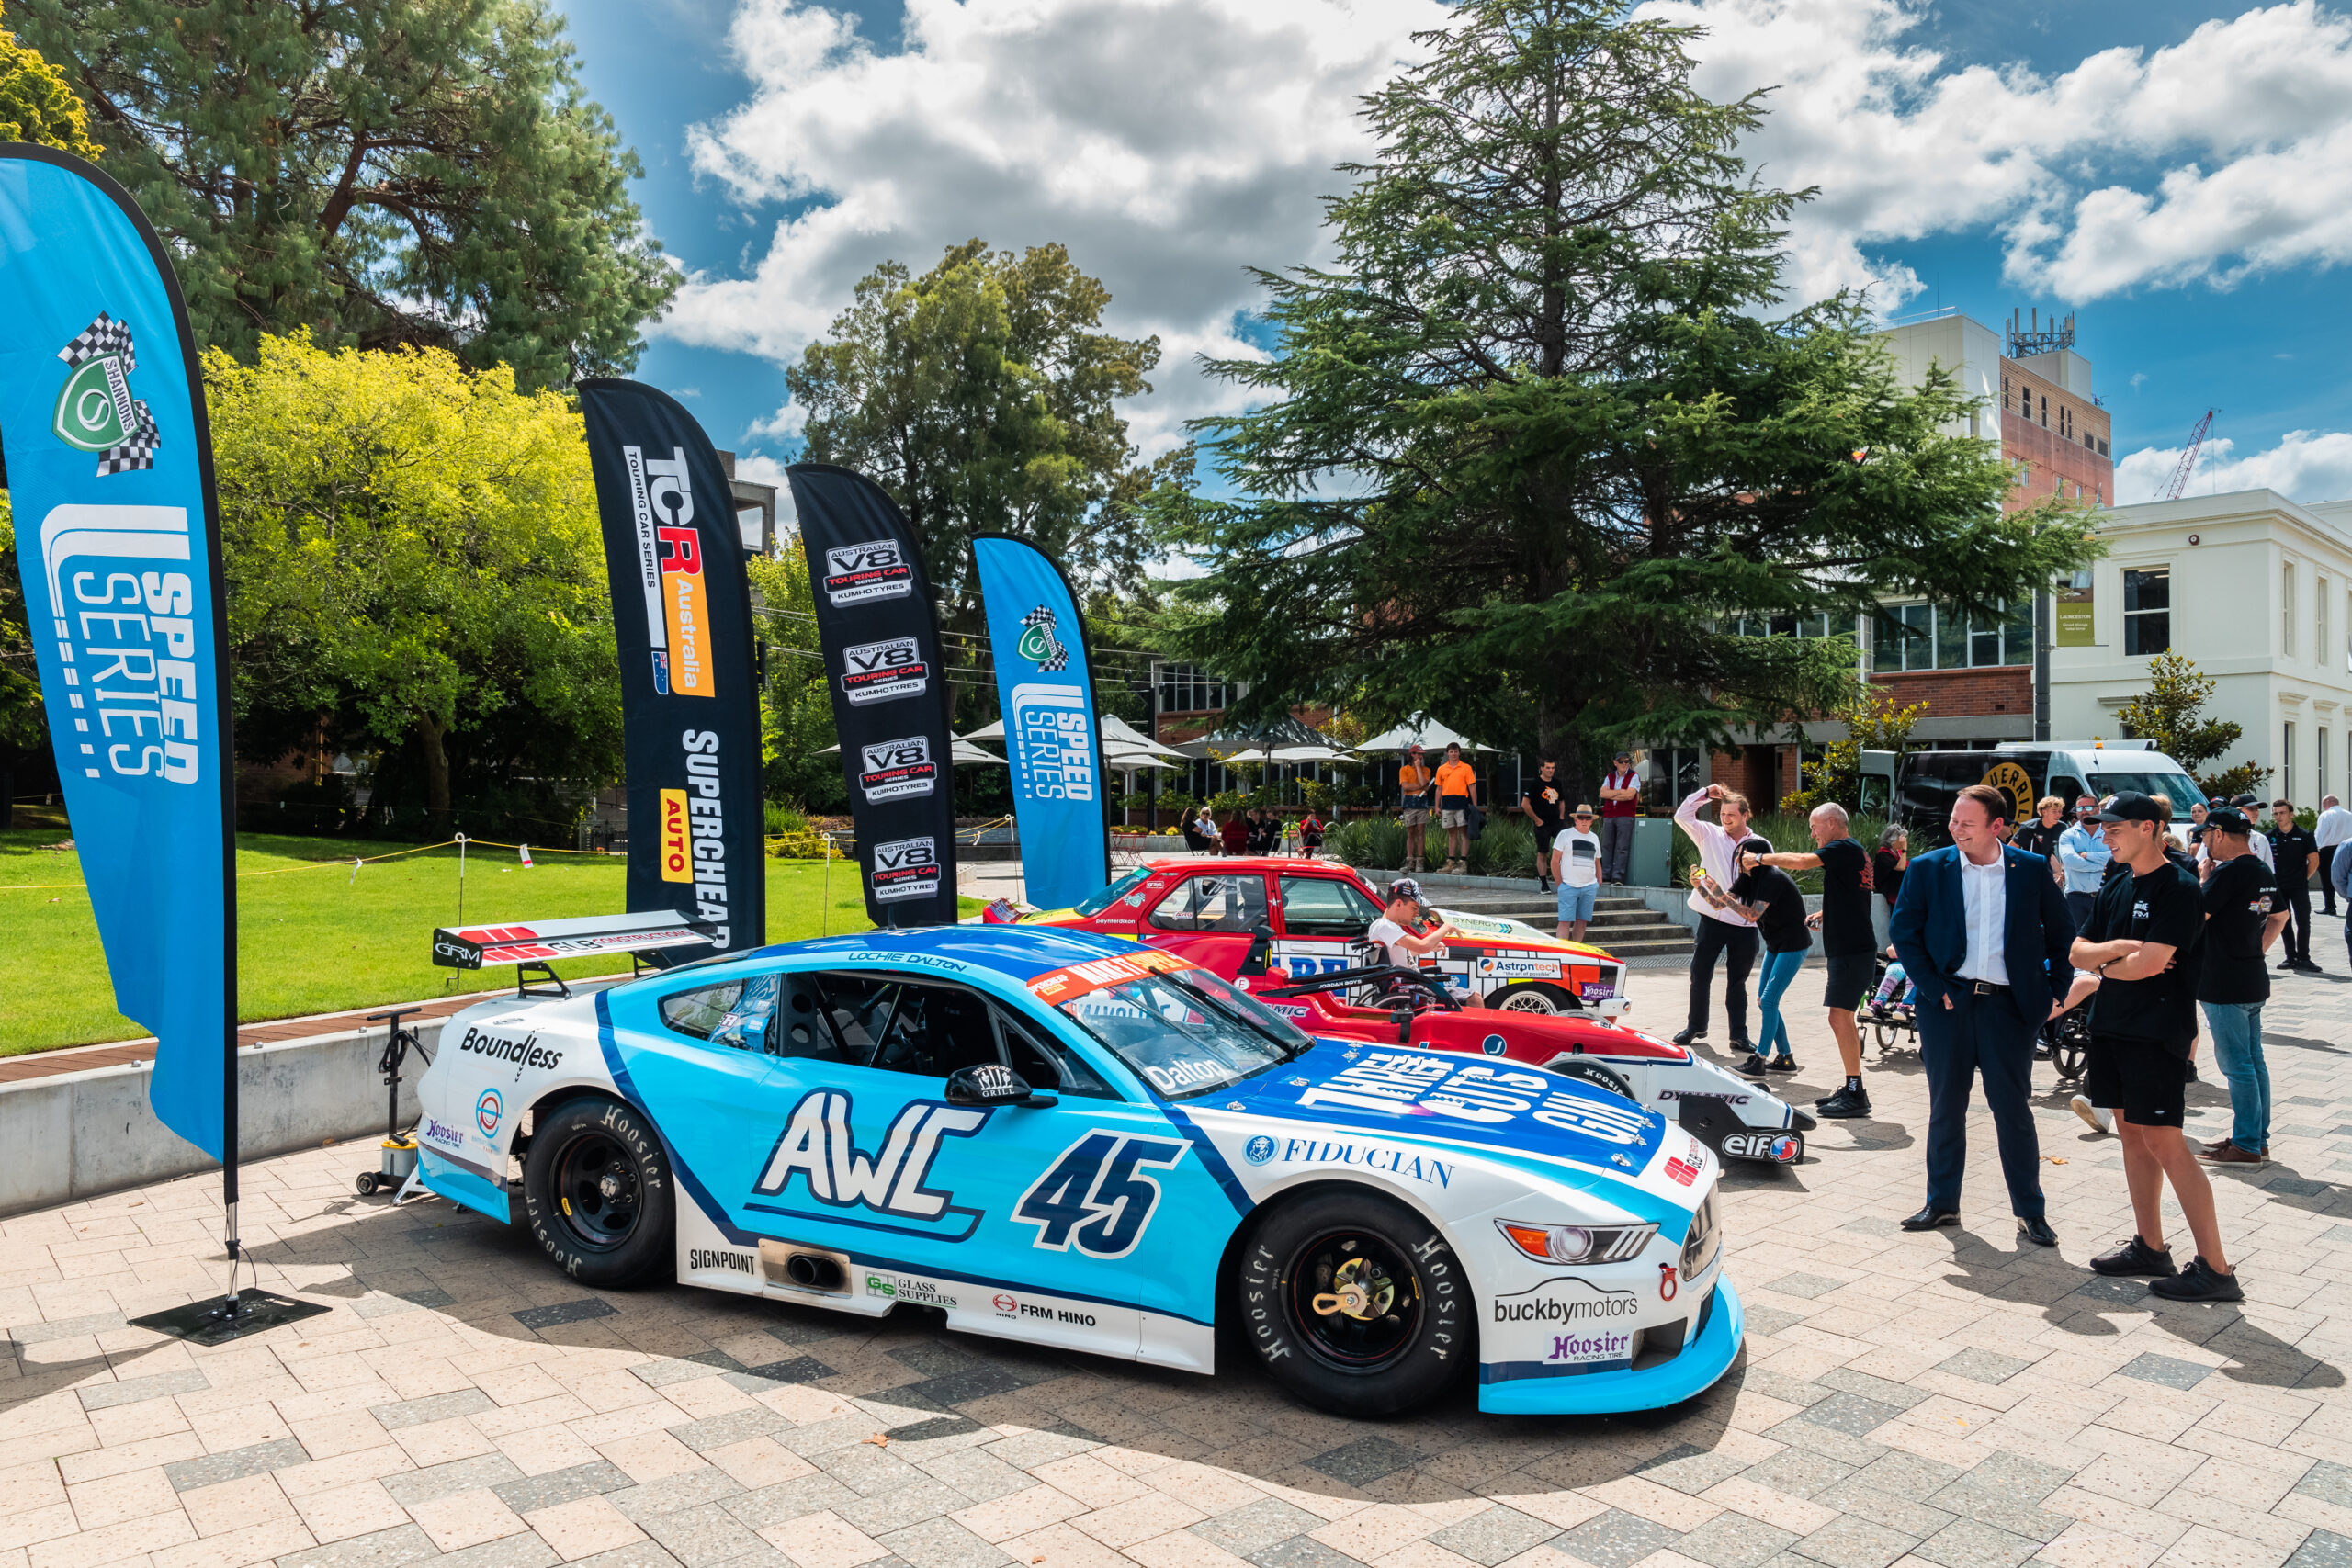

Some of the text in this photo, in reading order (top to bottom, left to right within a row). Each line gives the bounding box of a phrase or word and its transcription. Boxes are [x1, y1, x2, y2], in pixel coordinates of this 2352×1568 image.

[105, 359, 135, 433] SHANNONS
[628, 451, 656, 588] TOURING CAR SERIES
[646, 446, 703, 575] TCR
[831, 543, 895, 558] AUSTRALIAN
[832, 550, 898, 571] V8
[828, 567, 908, 585] TOURING CAR
[838, 583, 904, 599] KUMHO TYRES
[676, 578, 699, 688] Australia
[849, 640, 914, 657] AUSTRALIAN
[850, 649, 915, 670] V8
[74, 571, 164, 778] SERIES
[141, 571, 198, 784] SPEED
[845, 665, 923, 684] TOURING CAR
[855, 682, 919, 698] KUMHO TYRES
[866, 740, 924, 755] AUSTRALIAN
[867, 747, 925, 769] V8
[1025, 711, 1065, 799] SERIES
[1057, 712, 1092, 801] SPEED
[864, 765, 933, 782] TOURING CAR
[872, 782, 928, 796] KUMHO TYRES
[666, 797, 684, 873] AUTO
[877, 840, 933, 854] AUSTRALIAN
[878, 847, 933, 868] V8
[875, 866, 937, 881] TOURING CAR
[879, 883, 935, 895] KUMHO TYRES
[1453, 917, 1498, 927] SYNERGY
[435, 942, 480, 963] GRM
[547, 930, 694, 953] GLB CONSTRUCTIONS
[849, 952, 967, 973] LOCHIE DALTON
[1066, 959, 1135, 985] MAKE
[1109, 957, 1148, 975] IT
[1496, 961, 1559, 971] Astrontech
[1318, 981, 1343, 989] JORDAN
[460, 1027, 563, 1069] Boundless
[1144, 1059, 1227, 1090] Dalton
[982, 1089, 1014, 1097] GRILL
[426, 1119, 463, 1144] Hoosier
[600, 1105, 662, 1189] Hoosier
[755, 1089, 992, 1220] AWC
[1724, 1134, 1770, 1156] elf
[1281, 1137, 1456, 1190] FIDUCIAN
[1010, 1128, 1193, 1260] 45
[526, 1196, 582, 1277] Hoosier
[690, 1249, 754, 1275] SIGNPOINT
[867, 1277, 896, 1295] GS
[898, 1279, 936, 1292] GLASS
[899, 1289, 957, 1306] SUPPLIES
[1245, 1244, 1292, 1363] Hoosier
[1410, 1235, 1455, 1360] Hoosier
[1021, 1303, 1096, 1327] FRM HINO
[1494, 1296, 1637, 1325] buckbymotors
[1547, 1331, 1629, 1360] Hoosier
[1574, 1353, 1605, 1361] RACING
